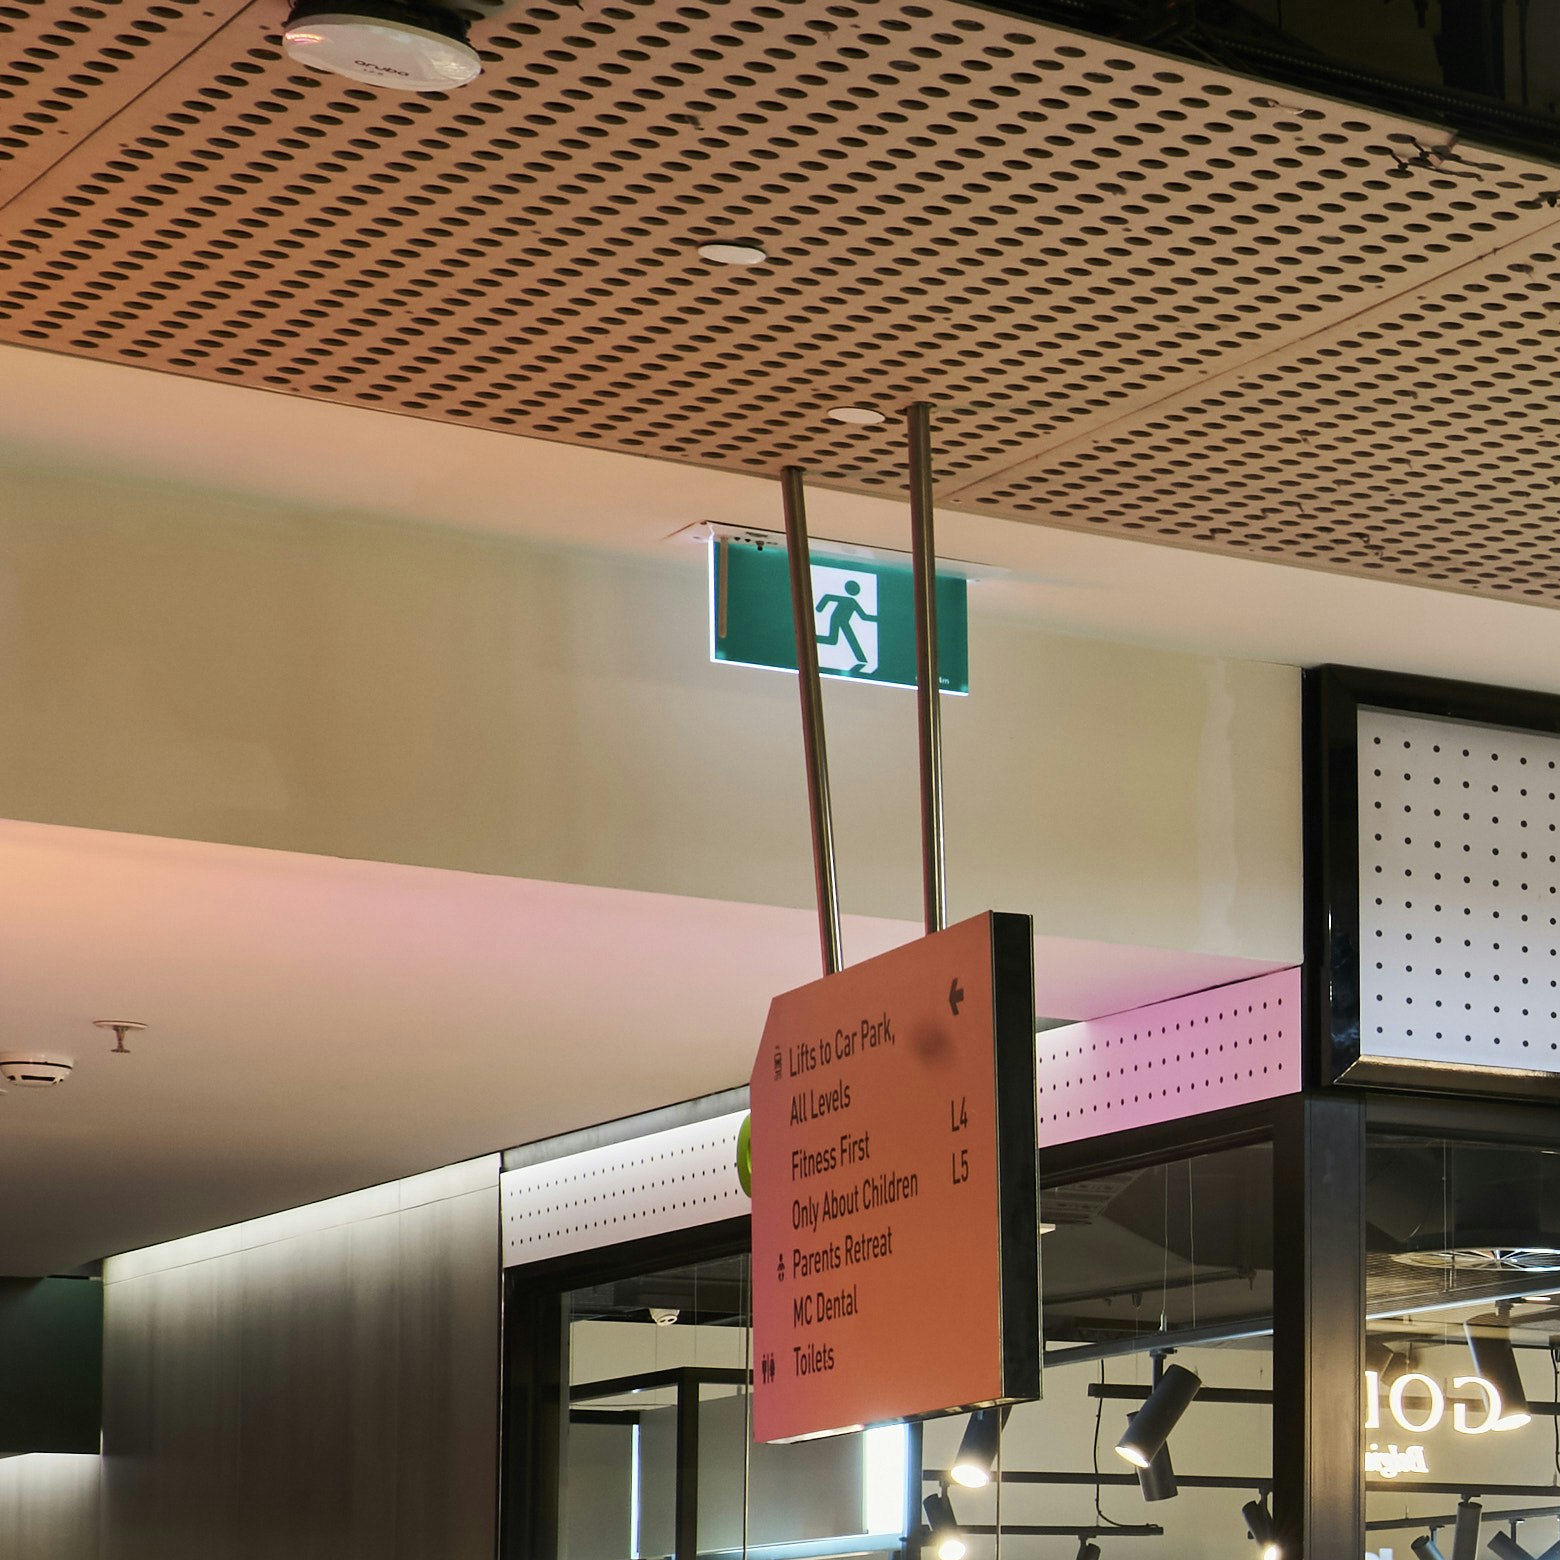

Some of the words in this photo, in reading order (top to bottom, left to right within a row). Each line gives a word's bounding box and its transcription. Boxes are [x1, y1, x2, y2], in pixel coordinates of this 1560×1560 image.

[789, 1043, 816, 1077] Lifts
[820, 1039, 832, 1066] to
[835, 1029, 857, 1061] Car
[861, 1012, 895, 1051] Park,
[790, 1092, 807, 1126] All
[811, 1079, 850, 1119] Levels
[792, 1148, 836, 1181] Fitness
[840, 1131, 870, 1167] First
[951, 1096, 968, 1132] L4
[792, 1196, 819, 1232] Only
[822, 1186, 859, 1222] About
[863, 1172, 918, 1210] Children
[952, 1149, 969, 1184] L5
[793, 1242, 841, 1279] Parents
[845, 1226, 892, 1265] Retreat
[794, 1295, 812, 1328] MC
[817, 1284, 858, 1323] Dental
[793, 1343, 834, 1376] Toilets
